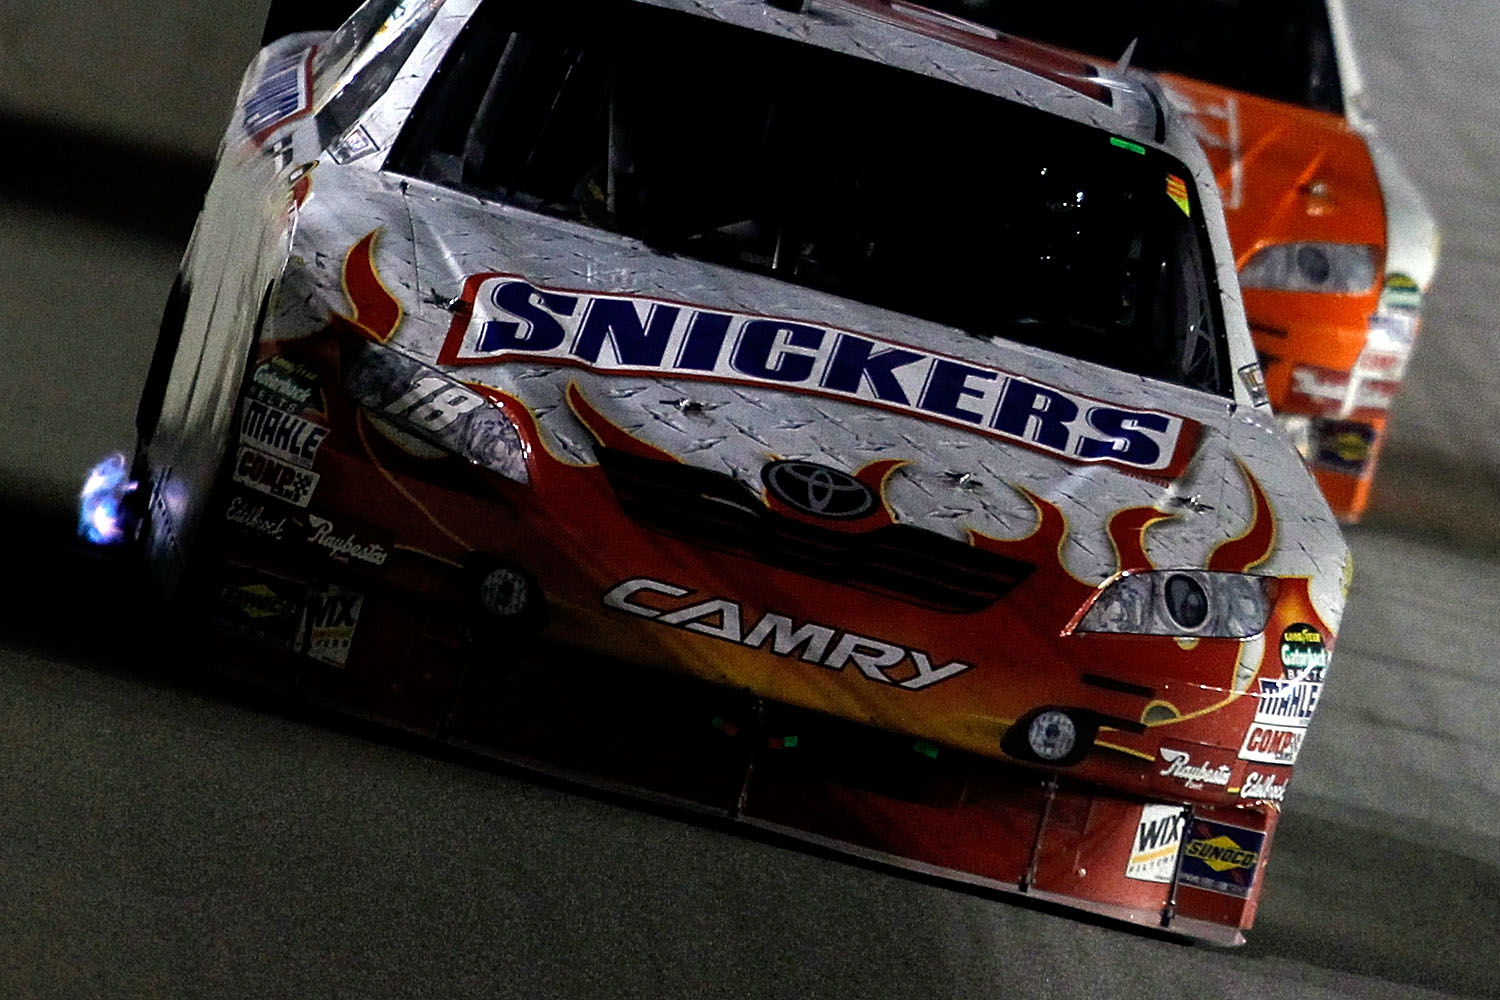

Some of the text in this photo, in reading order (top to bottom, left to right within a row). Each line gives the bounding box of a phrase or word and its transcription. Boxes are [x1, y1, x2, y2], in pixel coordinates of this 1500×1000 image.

[476, 280, 1172, 467] SNICKERS
[383, 376, 486, 432] 18
[244, 401, 325, 459] MAHLE
[238, 450, 297, 492] COMP
[602, 577, 972, 691] CAMRY
[1259, 681, 1320, 718] MAHLE
[1247, 727, 1293, 755] COMP
[1138, 814, 1184, 853] WIX
[1188, 842, 1256, 868] SUNOCO
